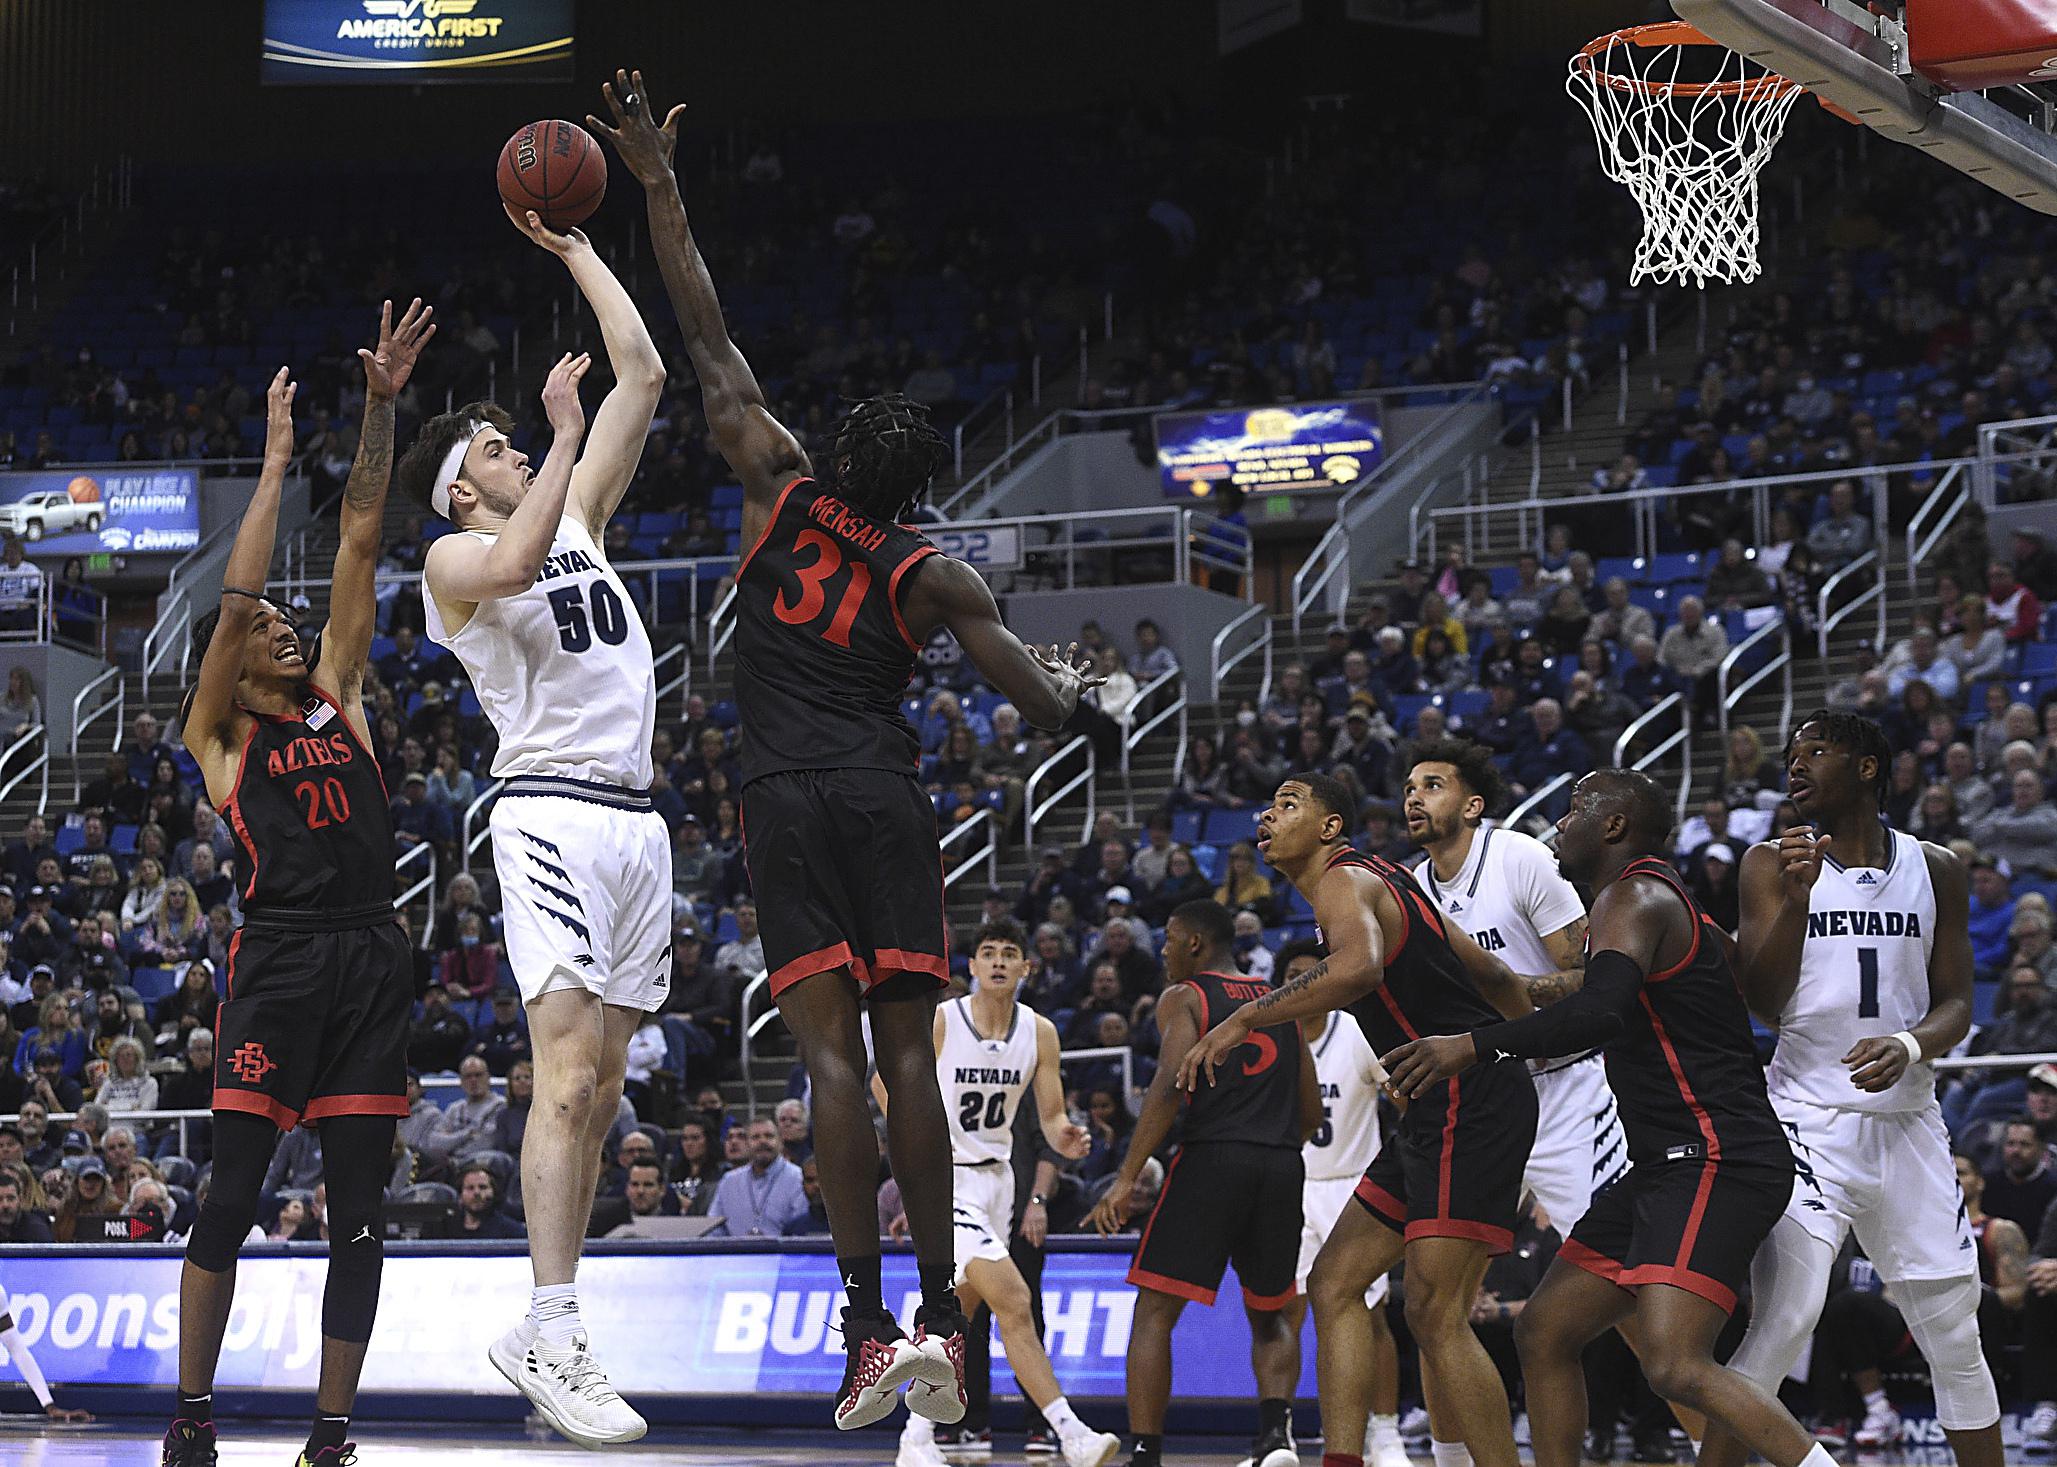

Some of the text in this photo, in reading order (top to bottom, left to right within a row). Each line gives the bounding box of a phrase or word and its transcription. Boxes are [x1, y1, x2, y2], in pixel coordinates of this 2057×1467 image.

[337, 17, 503, 39] AMERICA FIRST
[109, 494, 187, 515] CHAMPION
[808, 495, 887, 552] MENSAH
[773, 528, 872, 648] 31
[546, 579, 628, 654] 50
[294, 776, 350, 830] 20
[1808, 910, 1921, 939] NEVADA
[1857, 947, 1880, 1018] 1
[954, 1067, 1021, 1085] NEVADA
[959, 1091, 1007, 1132] 20
